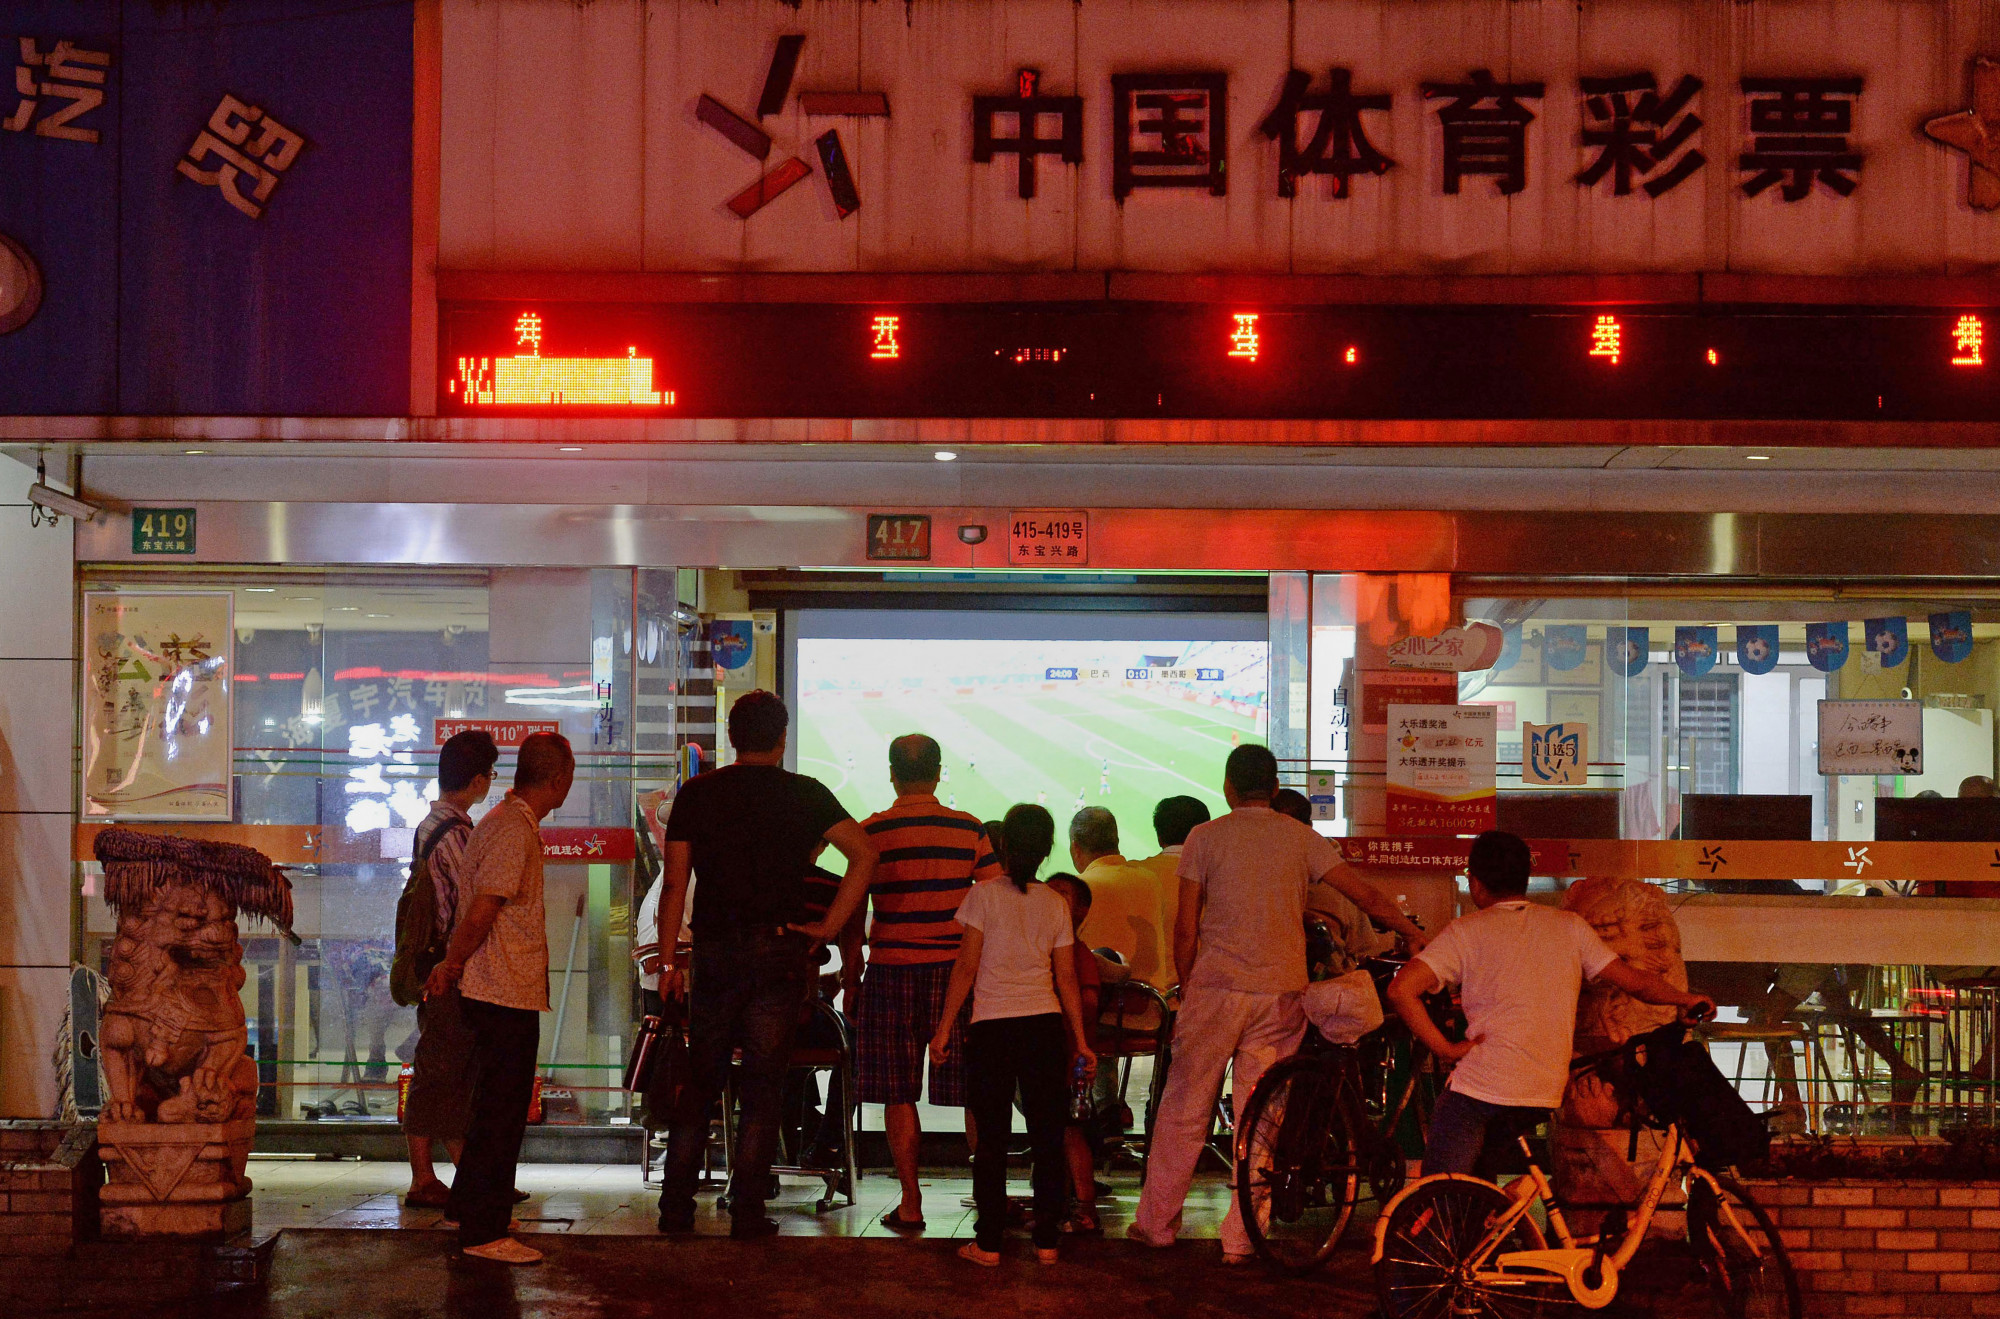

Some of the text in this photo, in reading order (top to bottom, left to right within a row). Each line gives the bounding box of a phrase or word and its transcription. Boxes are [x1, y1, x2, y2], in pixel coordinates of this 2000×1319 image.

[972, 65, 1865, 202] 中国体育彩票
[141, 514, 187, 538] 419
[875, 520, 922, 544] 417
[1012, 521, 1084, 540] 415-419号
[142, 541, 186, 551] 东宝兴路
[1018, 544, 1079, 557] 东宝兴路
[1127, 669, 1147, 680] 0:0
[1330, 685, 1349, 750] 自动门
[1400, 719, 1447, 729] 大乐透奖池
[1464, 737, 1484, 748] 亿元
[1399, 757, 1466, 767] 大乐透开奖提示
[1368, 841, 1414, 852] 你我携手
